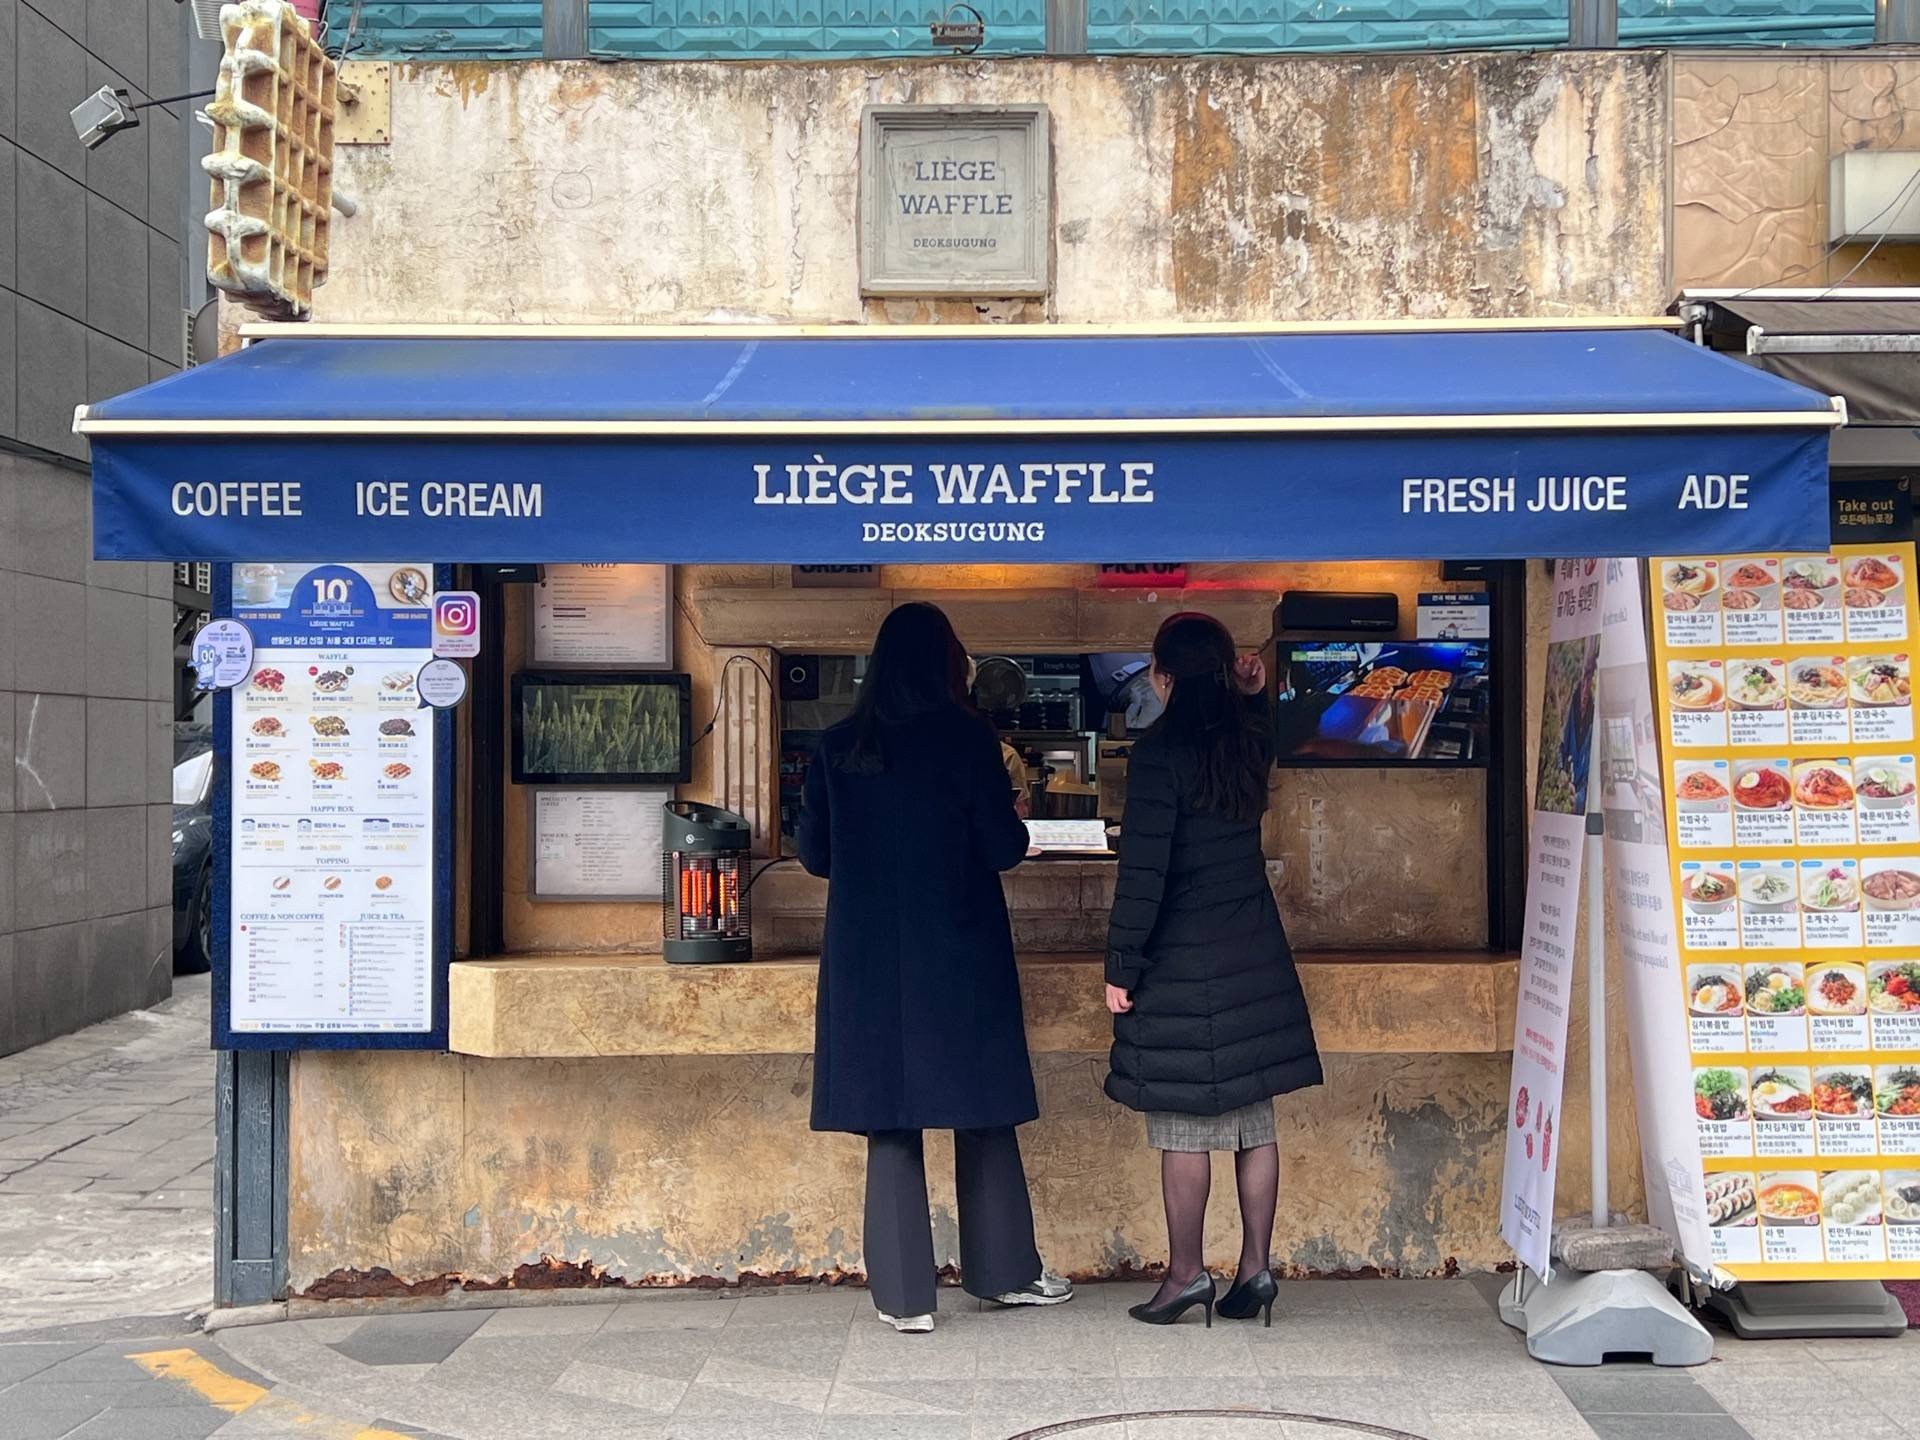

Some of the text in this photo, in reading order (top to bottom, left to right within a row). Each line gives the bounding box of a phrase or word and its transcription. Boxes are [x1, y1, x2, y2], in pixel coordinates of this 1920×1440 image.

[915, 156, 996, 181] LIÈGE
[899, 195, 1013, 215] WAFFLE
[913, 238, 997, 248] DEOKSUGUNG
[753, 454, 1154, 504] LIÈGE WAFFLE
[1402, 476, 1628, 513] FRESH JUICE
[1677, 474, 1750, 510] ADE
[171, 481, 302, 517] COFFEE
[356, 482, 542, 517] ICE CREAM
[1837, 499, 1894, 512] Take out
[862, 522, 1045, 542] DEOKSUGUNG
[1673, 714, 1711, 723] 할머니국수
[1732, 713, 1764, 722] 두부국수
[1679, 815, 1709, 824] 비빔국수
[1744, 916, 1785, 925] 검은콩국수
[1866, 913, 1909, 922] 돼지불고기
[1750, 1020, 1774, 1028] 비빔밥
[1713, 1229, 1721, 1239] 밥
